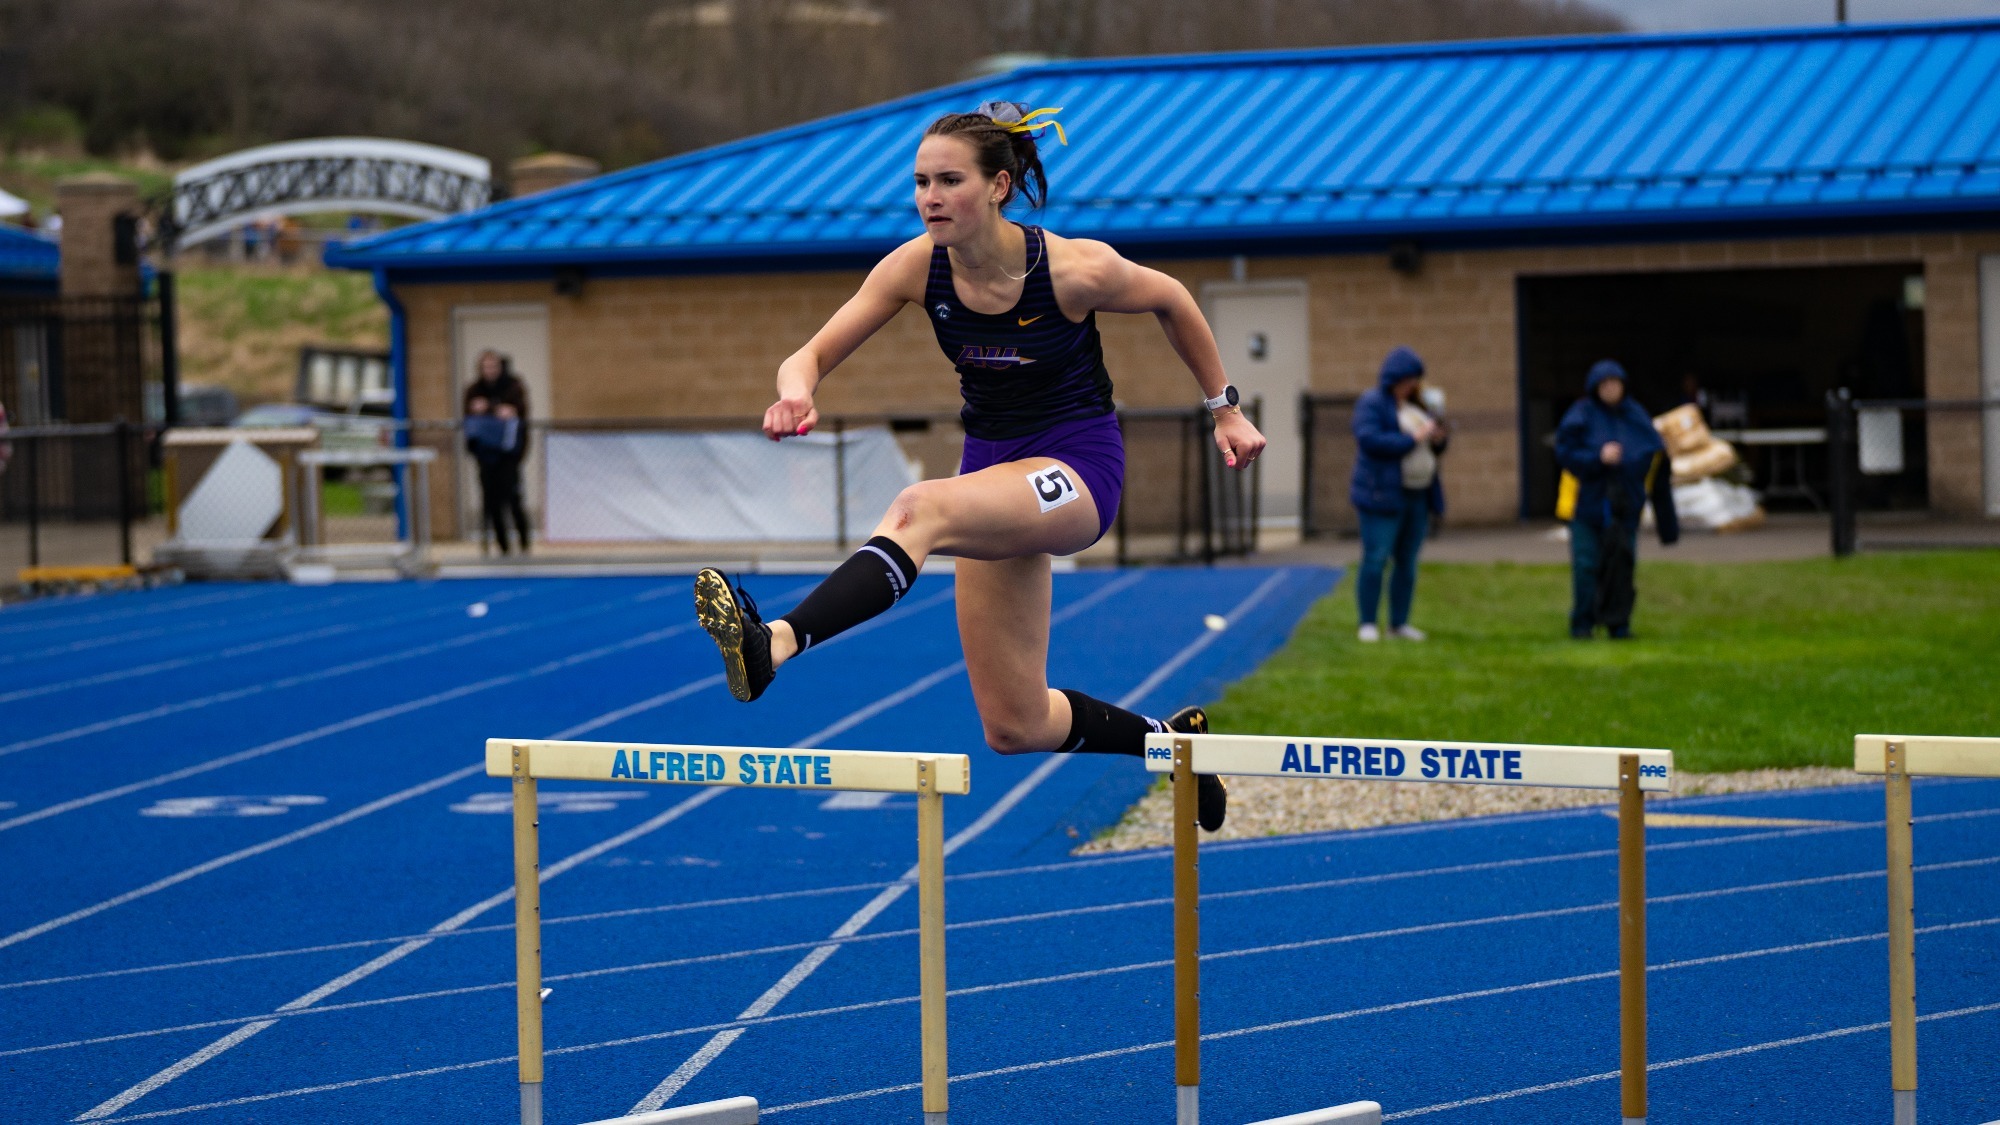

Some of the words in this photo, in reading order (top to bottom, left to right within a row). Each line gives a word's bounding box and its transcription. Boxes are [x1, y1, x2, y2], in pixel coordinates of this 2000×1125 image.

[956, 345, 1018, 370] AU
[1034, 469, 1074, 503] 5
[611, 749, 726, 782] ALFRED
[738, 753, 832, 785] STATE
[1280, 743, 1406, 777] ALFRED
[1420, 747, 1523, 780] STATE
